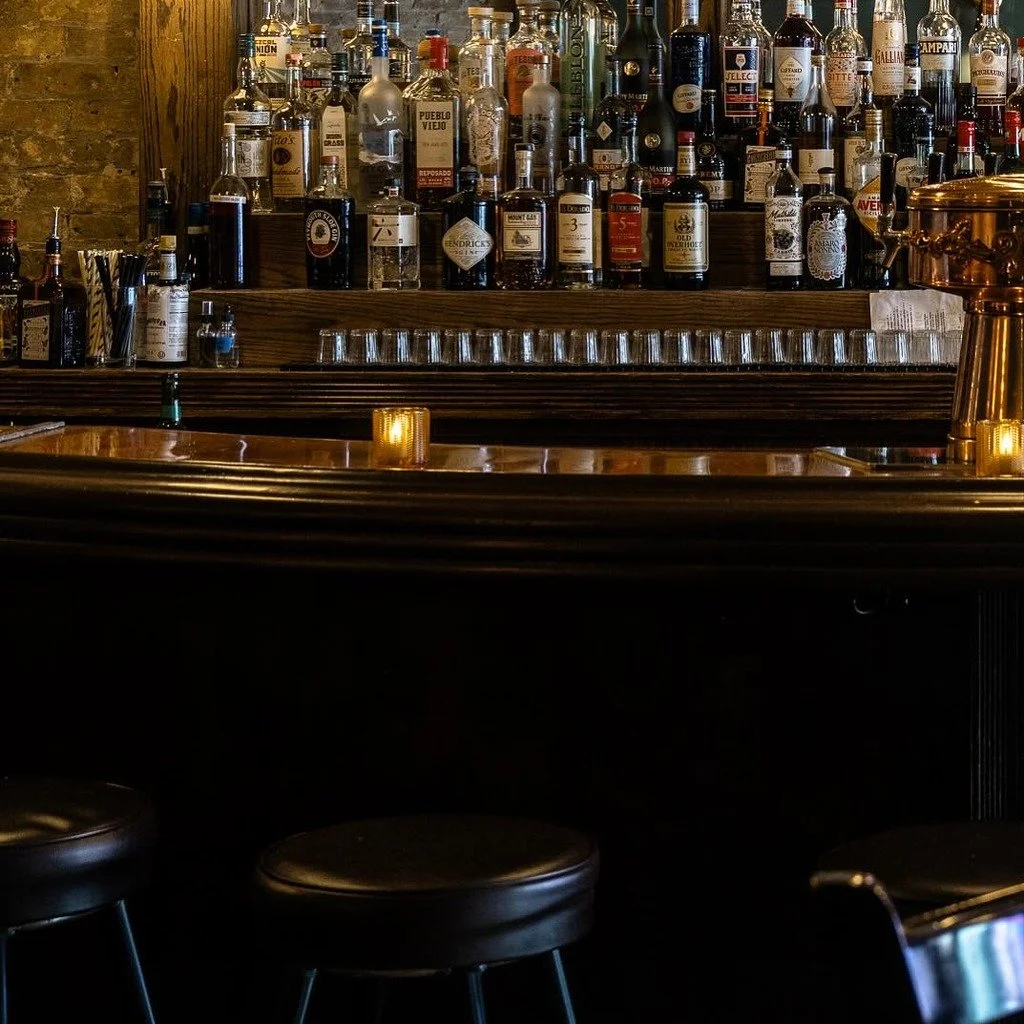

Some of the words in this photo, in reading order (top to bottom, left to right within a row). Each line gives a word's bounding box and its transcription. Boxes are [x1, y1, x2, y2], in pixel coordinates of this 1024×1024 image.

[920, 42, 957, 53] CAMPARI
[875, 49, 905, 65] GALLIAN
[725, 72, 757, 81] SELECT
[419, 111, 451, 120] PUEBLO
[422, 121, 447, 131] VIEJO
[419, 169, 452, 177] REPOSADO
[649, 165, 674, 173] MARTIN
[570, 218, 578, 232] 3
[619, 217, 627, 231] 5
